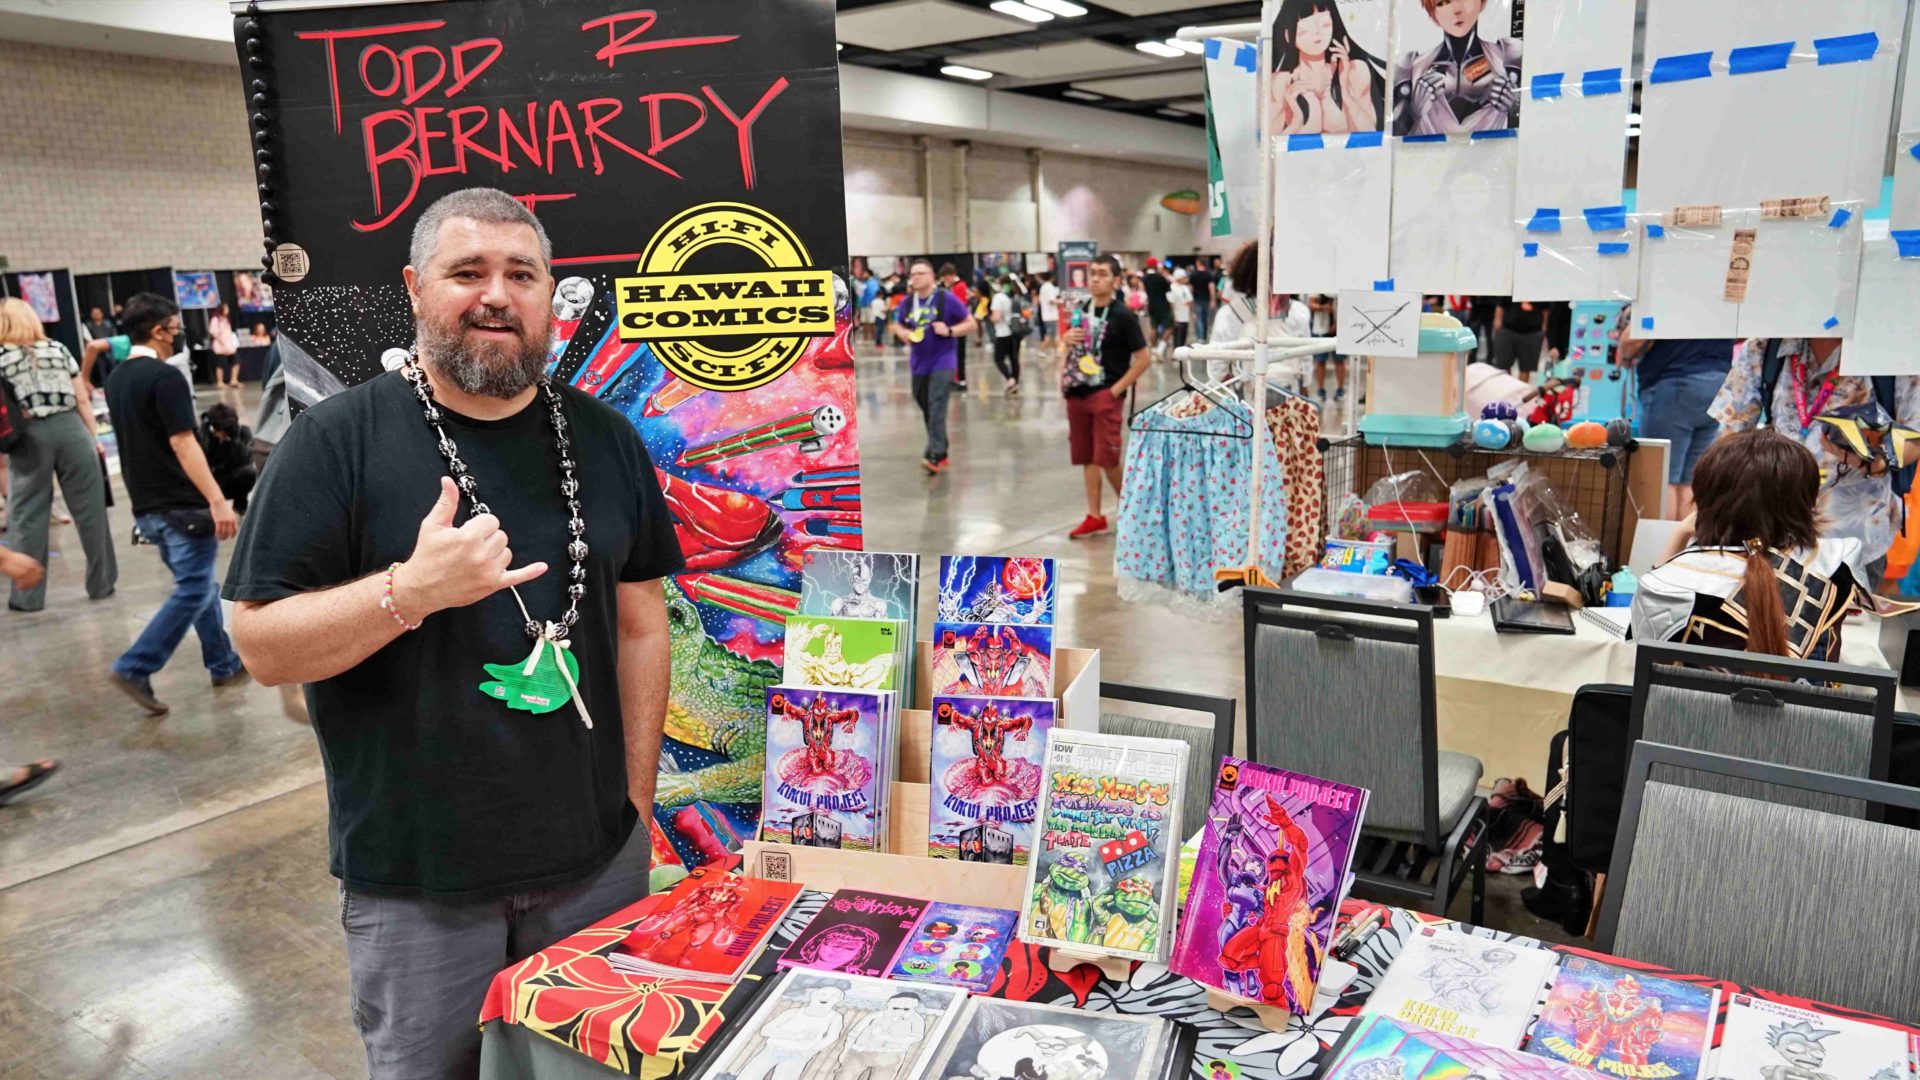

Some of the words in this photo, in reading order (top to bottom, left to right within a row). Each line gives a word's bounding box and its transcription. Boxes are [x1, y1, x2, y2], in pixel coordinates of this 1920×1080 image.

[297, 20, 503, 135] TODD
[582, 9, 740, 67] R
[350, 76, 790, 232] BERNARDY
[668, 219, 780, 253] HI-FI
[624, 279, 825, 303] HAWAII
[622, 306, 830, 328] COMICS
[668, 340, 790, 377] SCI-FI
[1054, 744, 1074, 754] IDW
[777, 782, 812, 806] KUKUI
[816, 788, 867, 812] PROJECT
[1240, 767, 1286, 794] KUKUI
[1286, 778, 1354, 811] PROJECT
[943, 794, 981, 819] KUKUI
[1106, 846, 1158, 879] PIZZA
[724, 930, 759, 957] KUKUI
[747, 896, 787, 931] PROJECT
